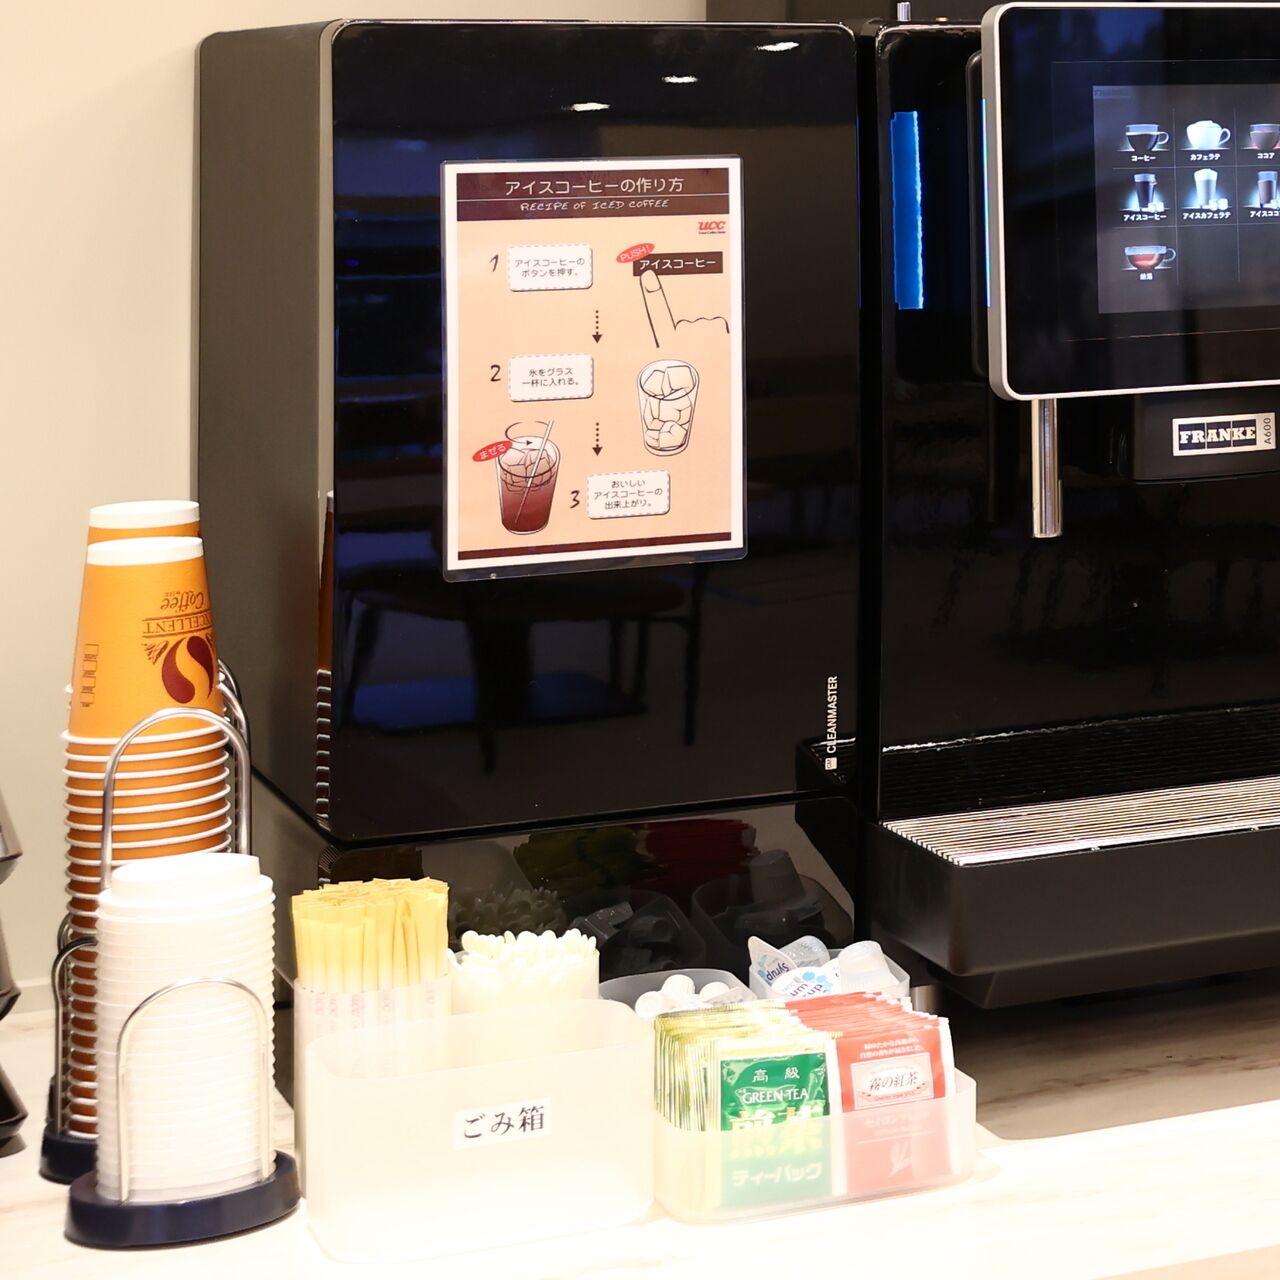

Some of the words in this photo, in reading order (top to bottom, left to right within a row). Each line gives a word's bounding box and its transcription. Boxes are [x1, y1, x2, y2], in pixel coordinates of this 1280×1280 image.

[1190, 153, 1221, 161] カフェラテ
[505, 177, 684, 195] アイスコーヒーの作り方
[521, 202, 569, 211] RECIPE
[573, 201, 586, 210] OF
[592, 201, 625, 210] ICED
[629, 199, 670, 208] COFFEE
[1123, 213, 1167, 221] アイスコーヒー
[1182, 211, 1231, 220] アイスカフェラテ
[620, 244, 651, 263] PUSH!
[489, 254, 499, 272] 1
[515, 257, 585, 268] アイスコーヒーの
[639, 259, 716, 271] アイスコーヒー
[521, 267, 579, 278] ボタンを押す。
[490, 364, 501, 382] 2
[528, 367, 574, 377] 氷をグラス
[522, 377, 580, 388] 一杯に入れる。
[1179, 426, 1256, 444] FRANKE
[1263, 417, 1272, 445] A600
[479, 442, 508, 461] まぜる
[611, 479, 646, 489] おいしい
[570, 490, 580, 509] 3
[593, 487, 663, 500] アイスコーヒーの
[604, 498, 652, 510] 出来上がり。
[160, 591, 204, 612] Coffee
[826, 676, 838, 754] CLEANMASTER
[766, 962, 790, 981] Syrup
[790, 983, 809, 997] um
[753, 1067, 800, 1082] 高級
[742, 1091, 784, 1104] GREEN
[786, 1088, 810, 1100] TEA
[464, 1105, 545, 1139] ごみ箱
